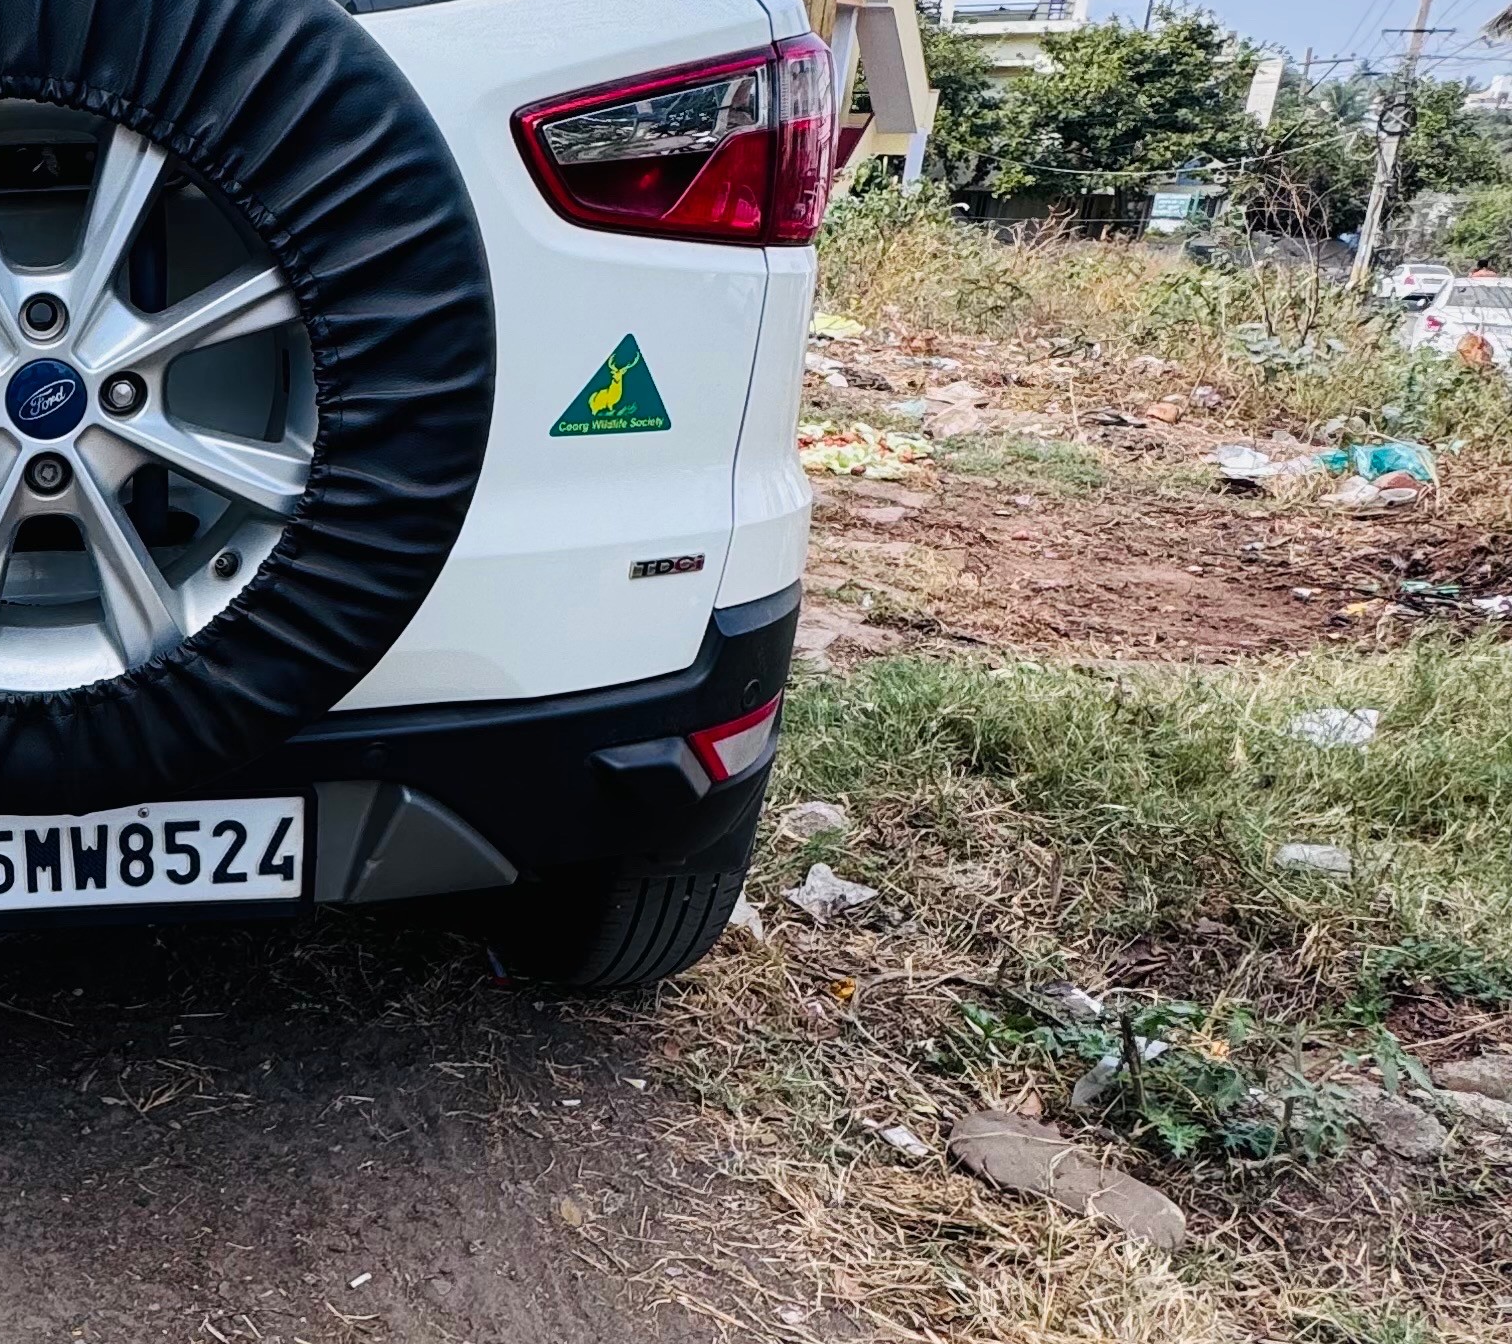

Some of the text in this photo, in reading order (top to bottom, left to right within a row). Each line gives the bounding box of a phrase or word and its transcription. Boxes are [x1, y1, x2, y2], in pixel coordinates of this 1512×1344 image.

[30, 385, 67, 416] Ford
[592, 418, 628, 430] Wildlife
[630, 416, 664, 428] Society
